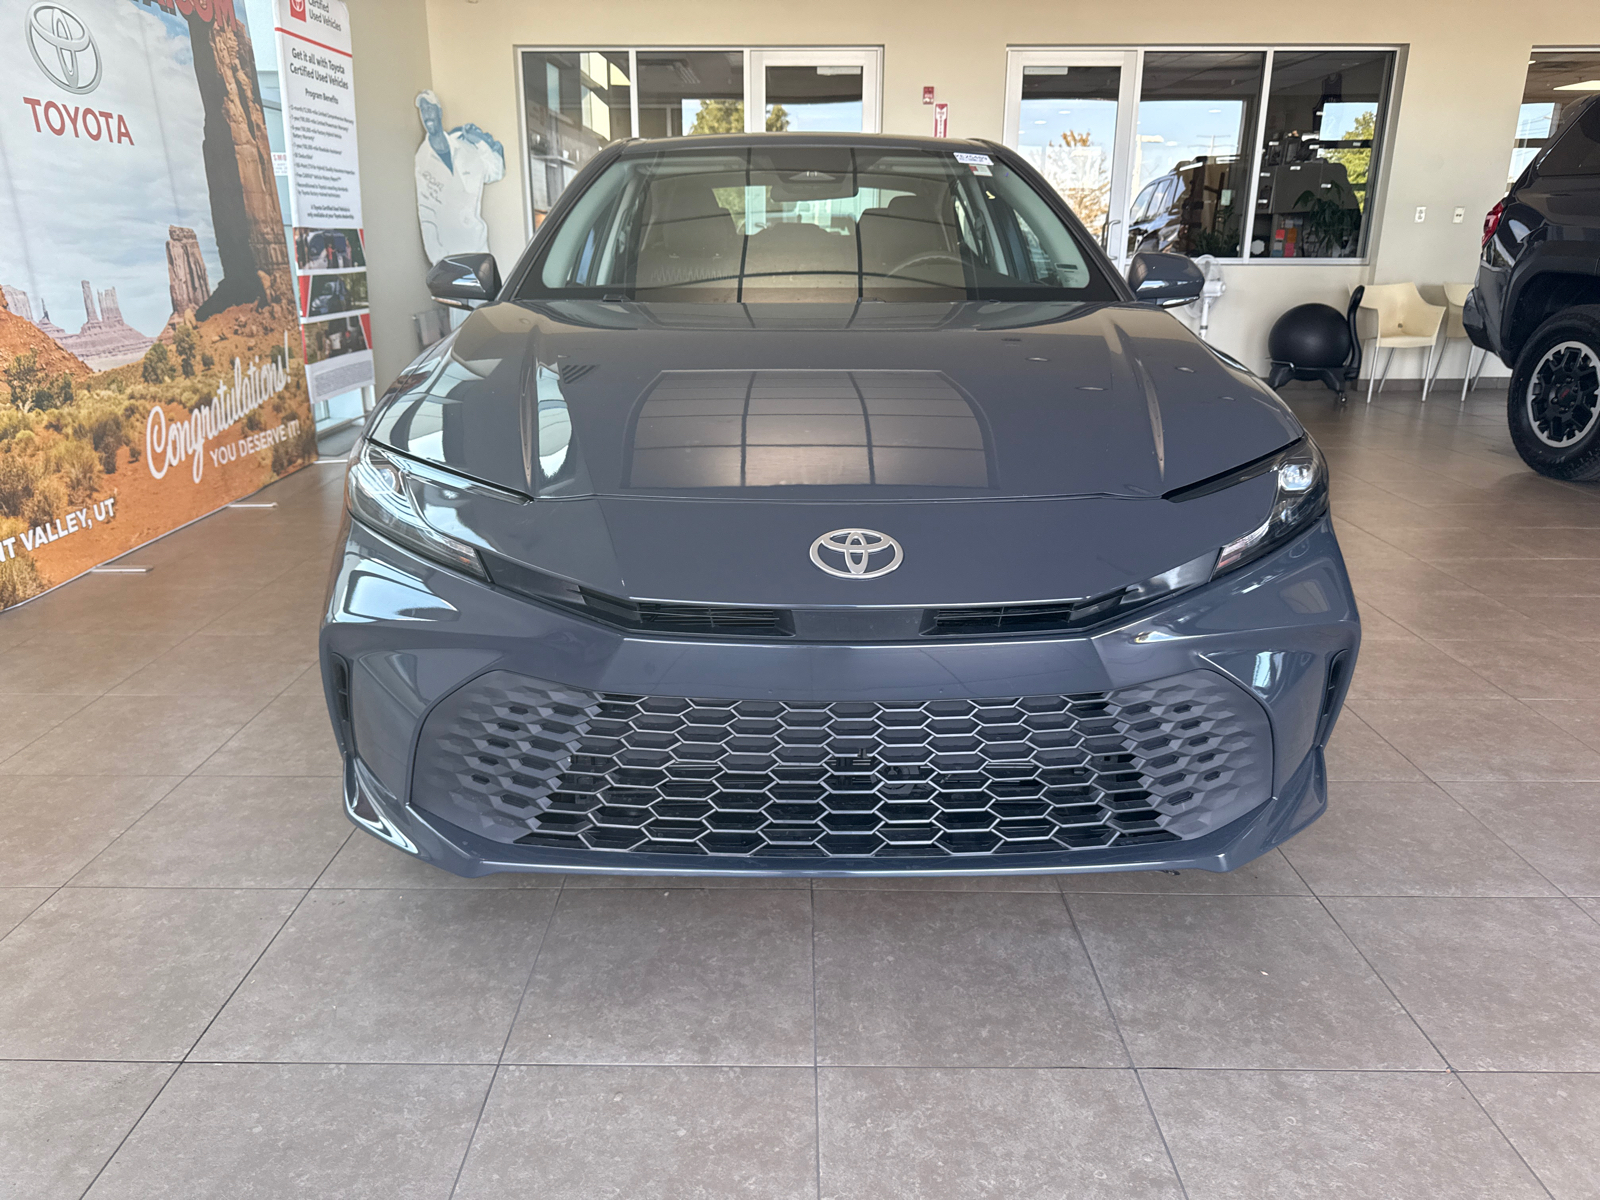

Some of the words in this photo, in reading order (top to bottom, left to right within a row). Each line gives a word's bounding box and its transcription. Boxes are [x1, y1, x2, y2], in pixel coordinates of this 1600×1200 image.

[309, 9, 322, 23] Used
[322, 14, 342, 31] Vehicles
[290, 62, 314, 79] Certified
[314, 70, 328, 83] Used
[328, 74, 348, 90] Vehicles
[292, 47, 303, 60] Get
[303, 50, 308, 62] it
[308, 53, 316, 65] all
[316, 56, 328, 69] with
[328, 59, 345, 74] Toyota
[305, 88, 322, 100] Program
[322, 93, 339, 105] Benefits
[22, 96, 135, 146] TOYOTA
[146, 330, 291, 484] Congratulations!
[210, 442, 236, 467] YOU
[238, 424, 287, 457] DESERVE
[287, 419, 301, 438] IT!
[19, 507, 93, 552] VALLEY,
[93, 497, 115, 522] UT
